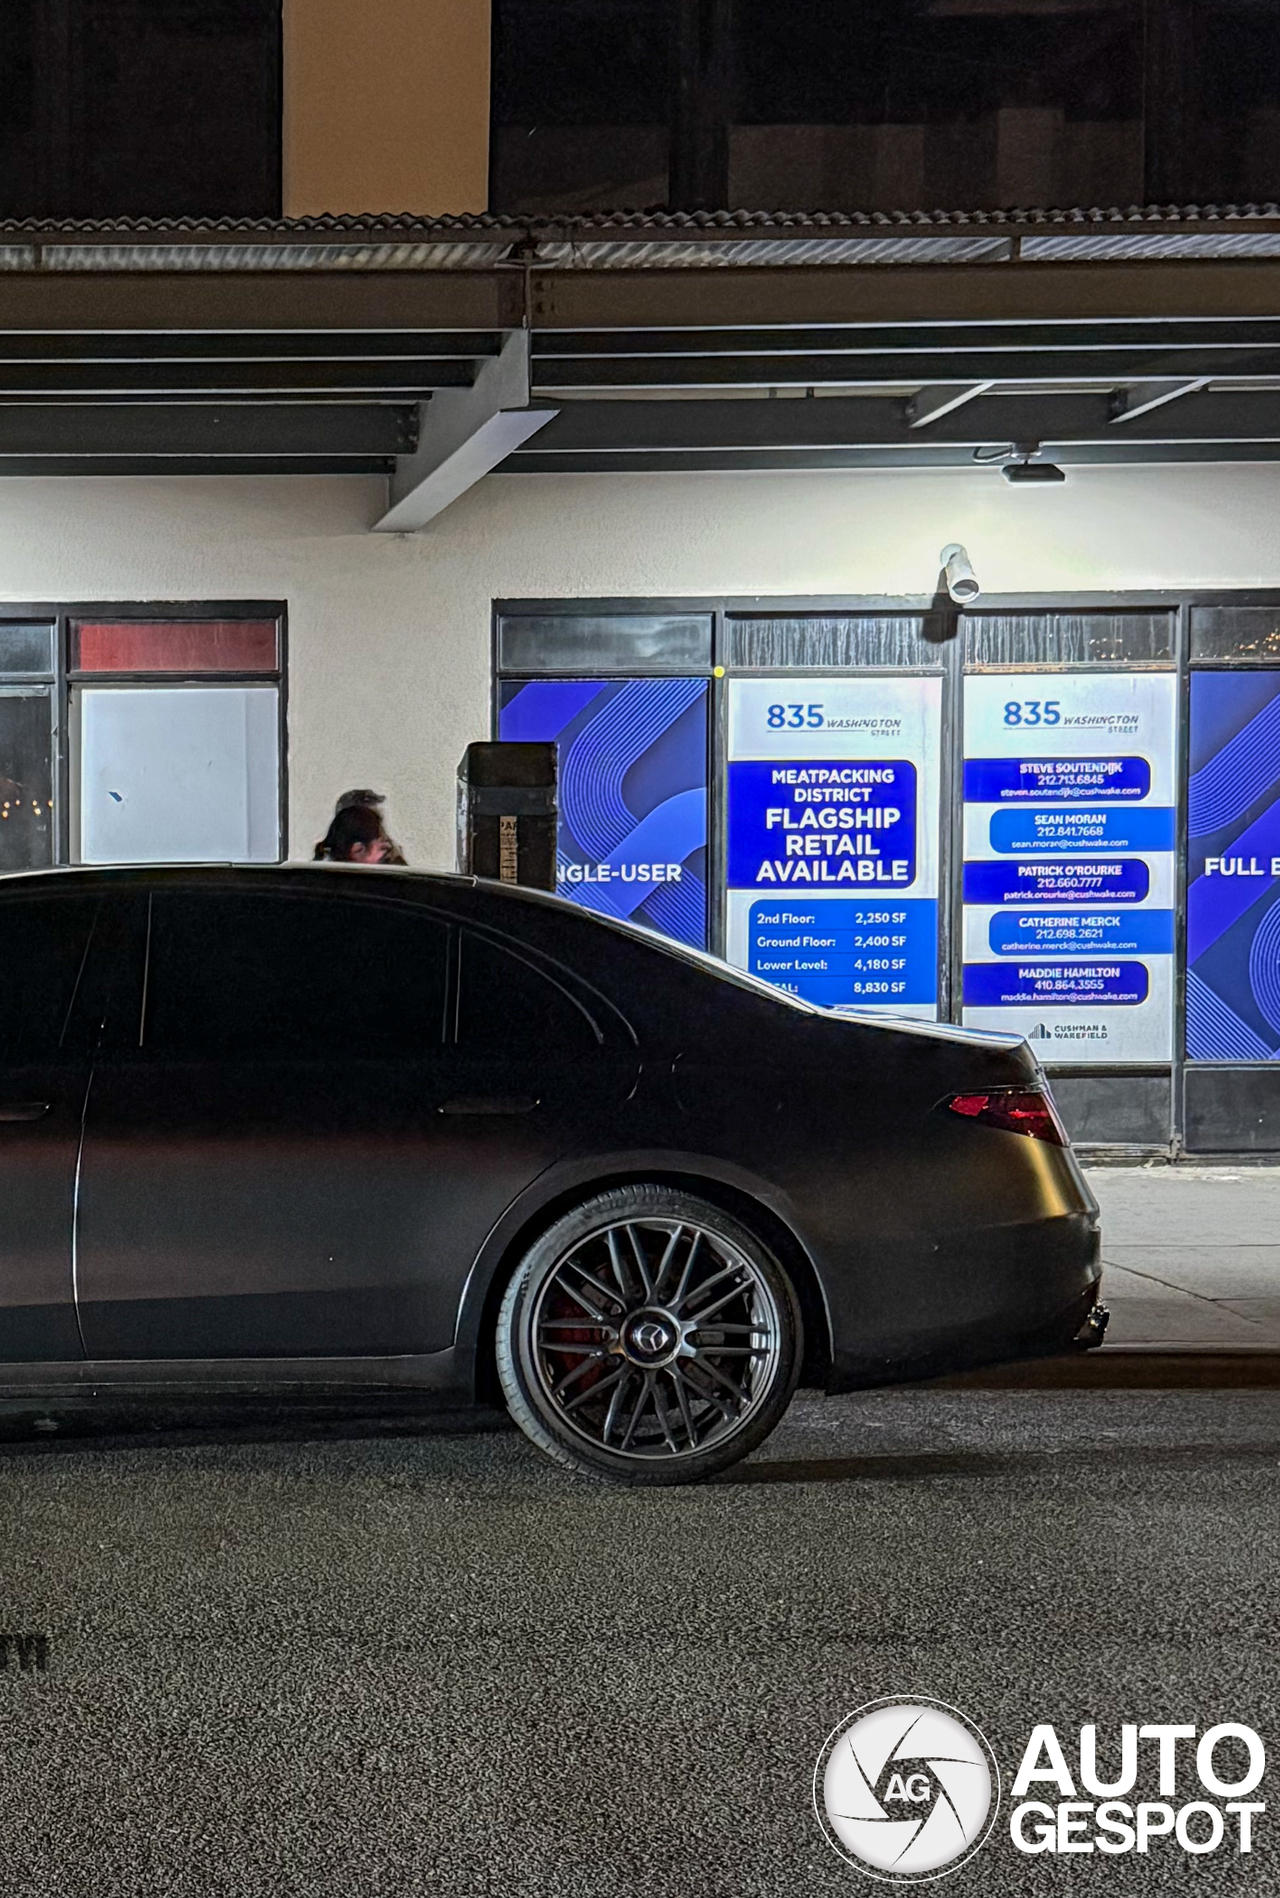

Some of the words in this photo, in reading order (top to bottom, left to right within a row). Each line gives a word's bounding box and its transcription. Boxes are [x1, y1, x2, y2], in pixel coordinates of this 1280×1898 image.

[767, 704, 825, 728] 835
[827, 719, 902, 728] WASHINGTON
[1003, 701, 1061, 725] 835
[1020, 763, 1054, 774] STEVE
[772, 769, 895, 784] MEATPACKING
[794, 788, 873, 802] DISTRICT
[766, 808, 901, 829] FLAGSHIP
[1035, 815, 1063, 825] SEAN
[1065, 814, 1107, 824] MORAN
[786, 834, 880, 855] RETAIL
[756, 860, 909, 882] AVAILABLE
[1018, 866, 1063, 877] PATRICK
[1205, 857, 1265, 876] FULL
[757, 913, 780, 924] 2nd
[782, 913, 815, 924] Floor:
[855, 912, 890, 925] 2,250
[891, 912, 907, 923] SF
[1019, 917, 1079, 928] CATHERINE
[1081, 916, 1121, 927] MERCK
[757, 936, 800, 947] Ground
[802, 936, 836, 947] Floor:
[854, 936, 890, 948] 2,400
[891, 935, 907, 947] SF
[757, 960, 793, 970] Lower
[794, 959, 828, 970] Level:
[854, 959, 889, 971] 4,180
[891, 958, 907, 970] SF
[1018, 968, 1062, 979] MADDIE
[1063, 967, 1121, 978] HAMILTON
[853, 982, 889, 994] 8,830
[891, 981, 906, 993] SF
